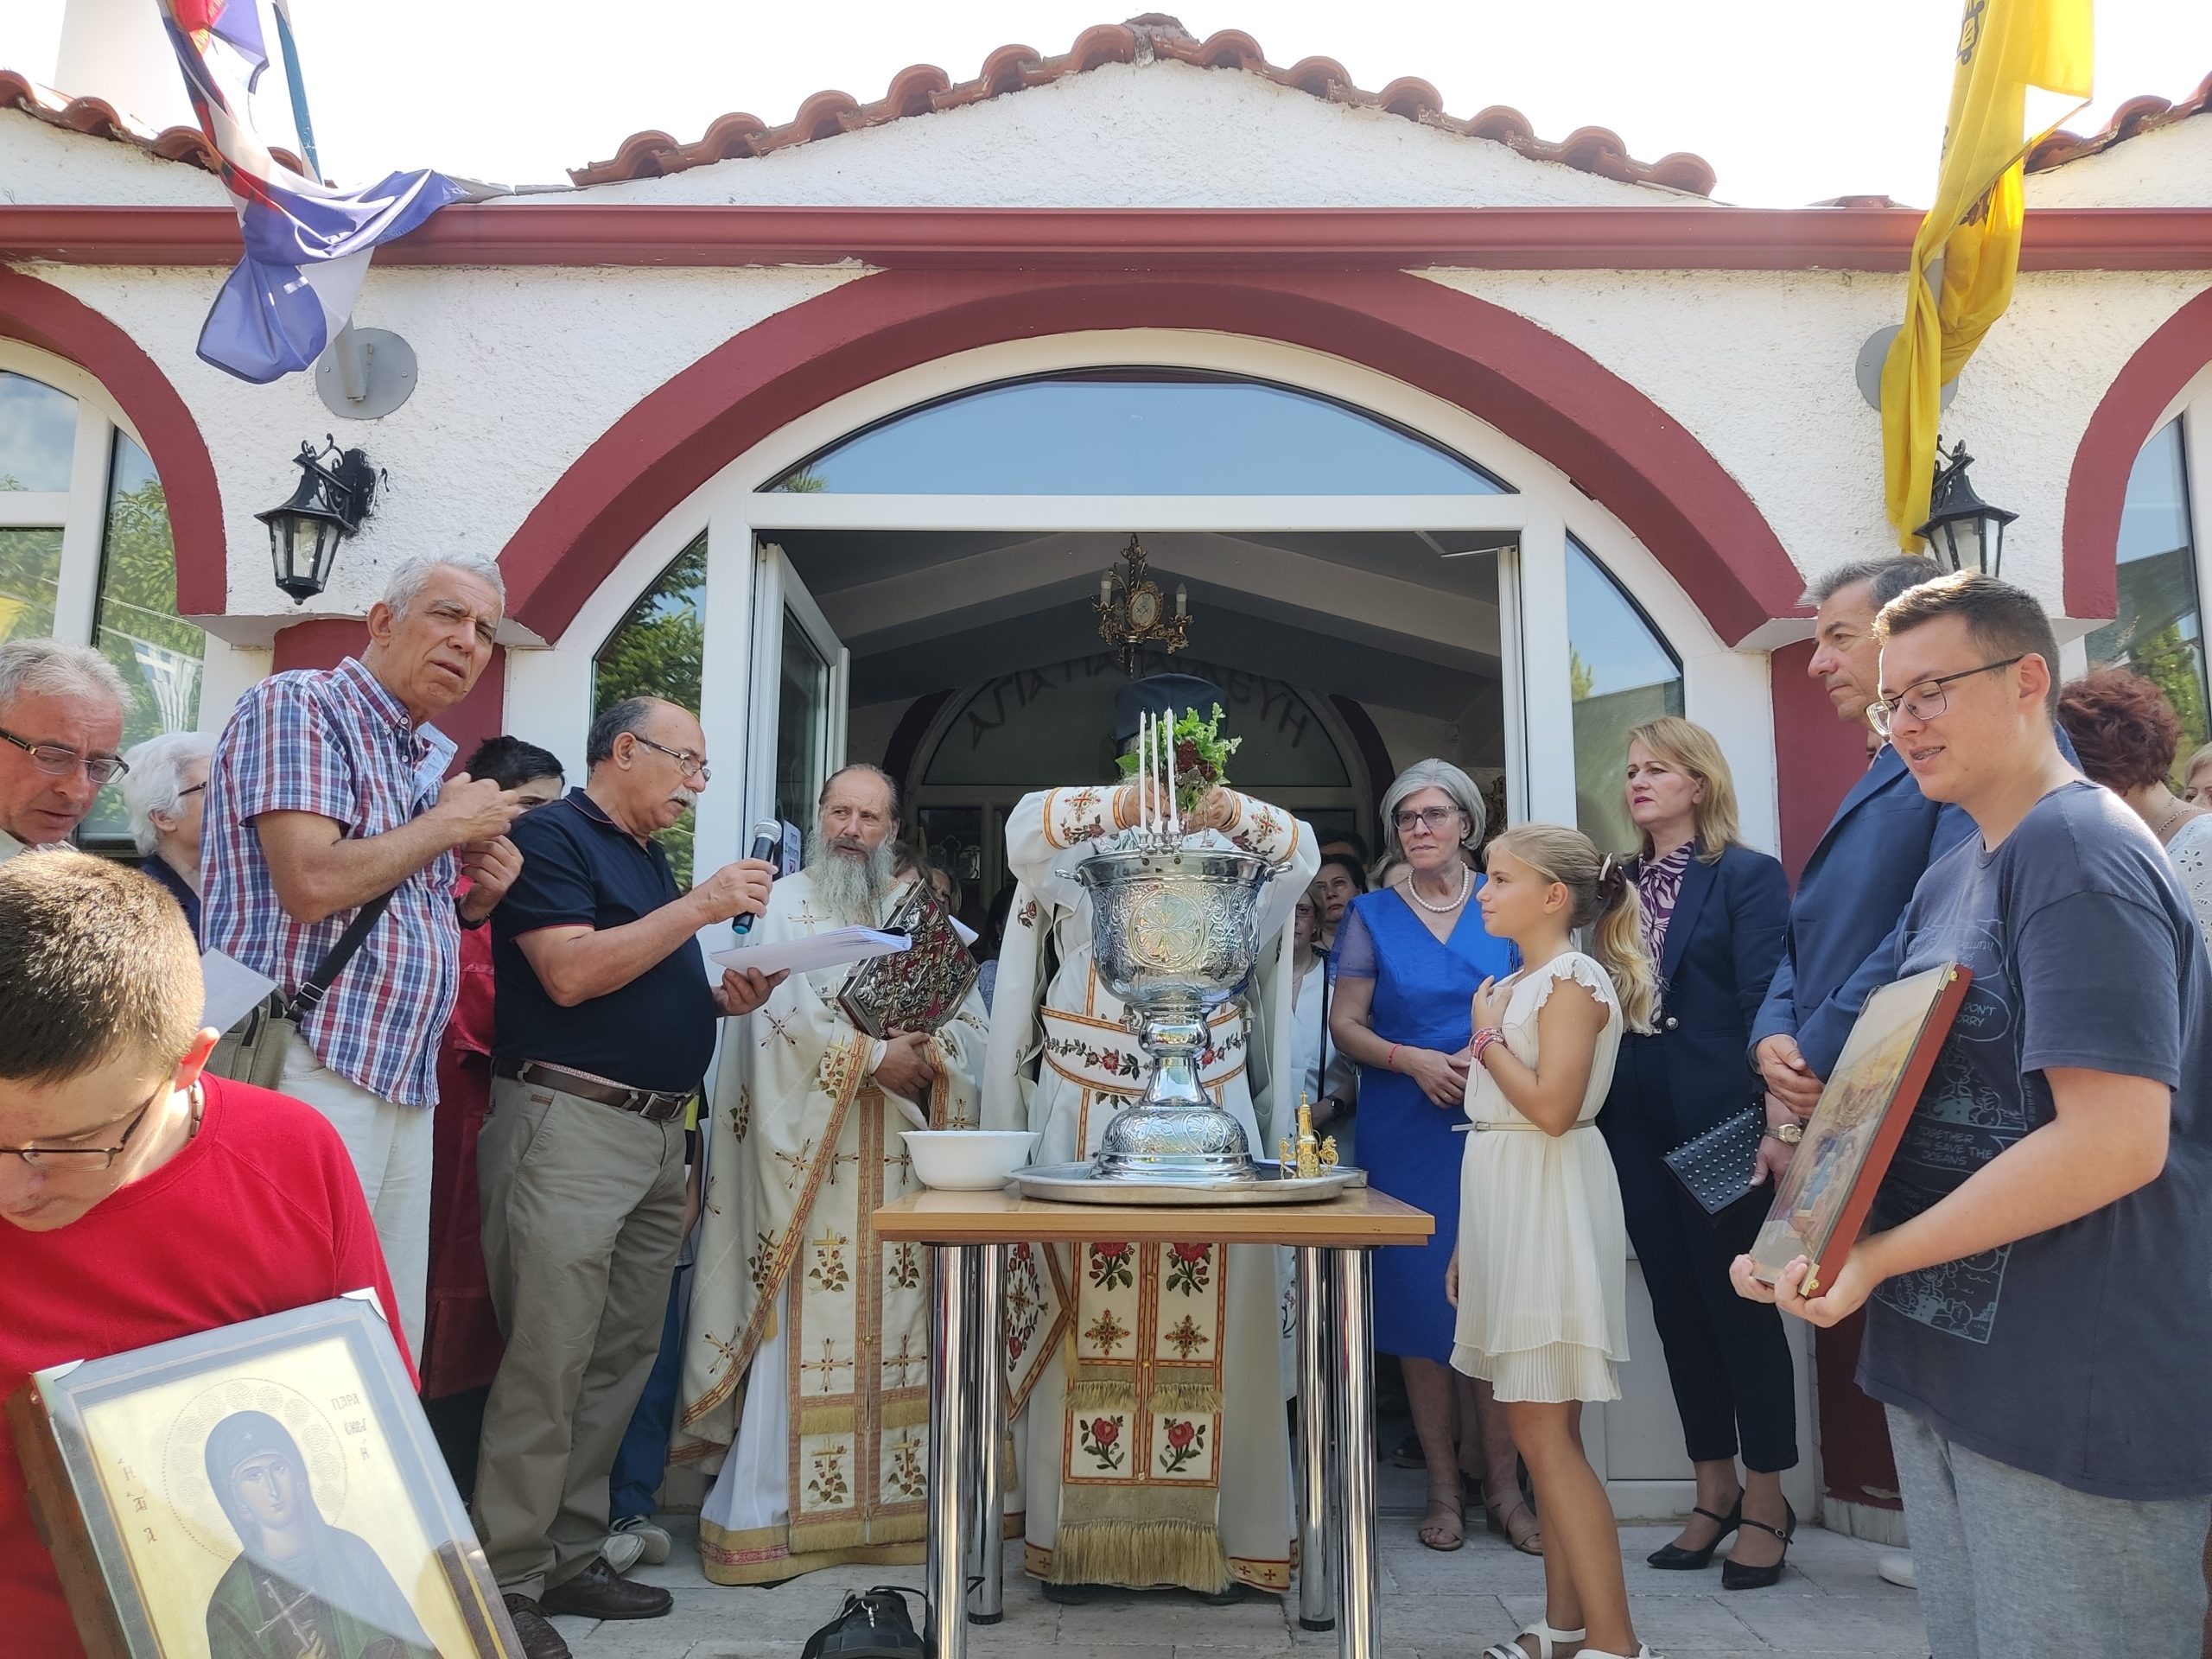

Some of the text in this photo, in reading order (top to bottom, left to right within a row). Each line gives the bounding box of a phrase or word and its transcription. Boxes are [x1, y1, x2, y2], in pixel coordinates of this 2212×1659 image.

[1964, 1002, 1997, 1016] DON'T
[1956, 1014, 1986, 1027] ORRY
[1935, 1141, 1965, 1154] SAVE
[1967, 1147, 1994, 1160] THE
